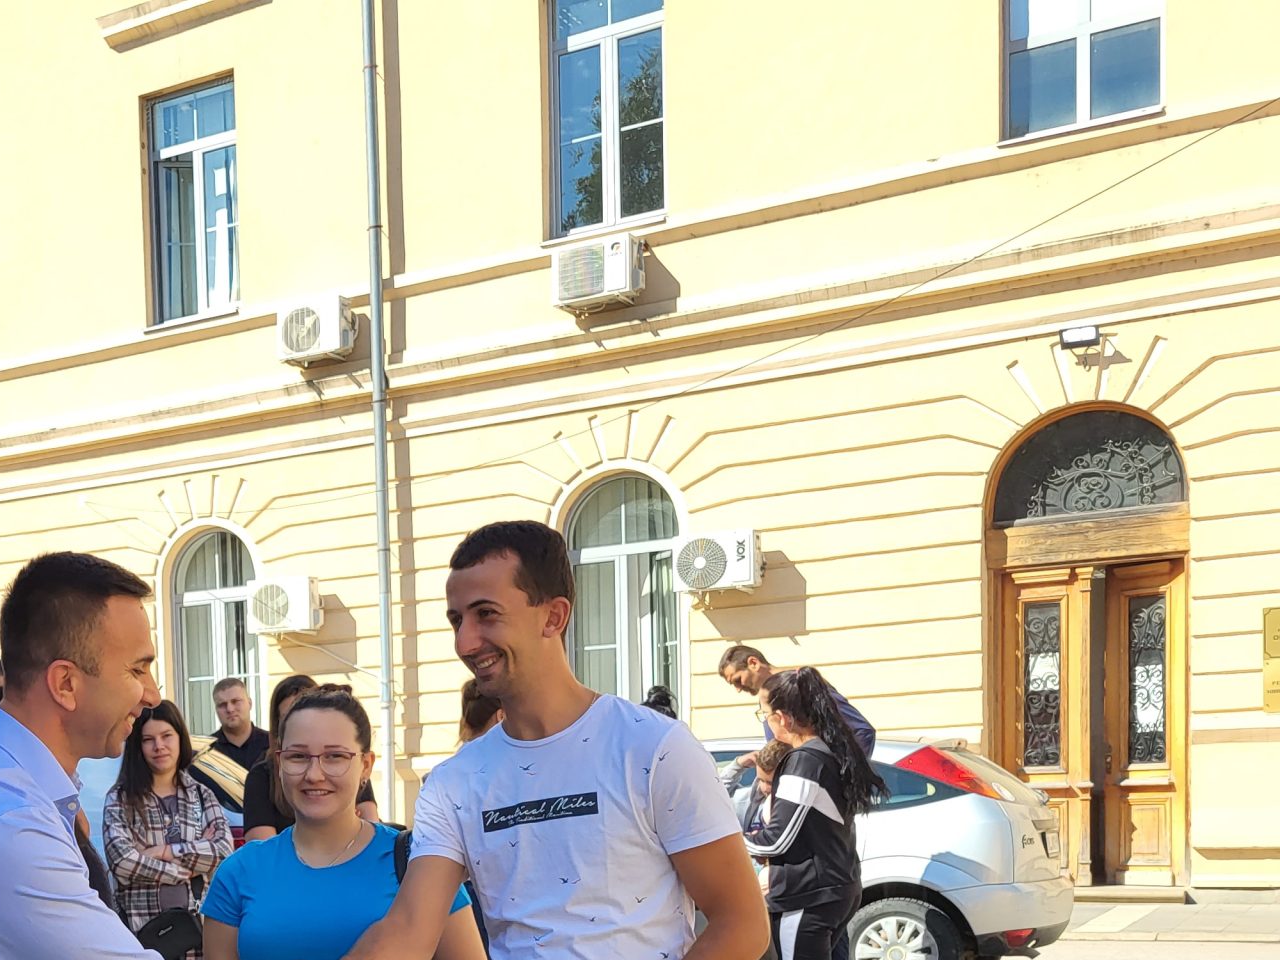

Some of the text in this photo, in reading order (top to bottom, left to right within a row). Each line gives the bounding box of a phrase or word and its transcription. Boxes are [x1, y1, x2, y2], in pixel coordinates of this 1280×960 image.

[736, 539, 746, 562] VOX
[485, 796, 596, 826] Nautical Miles
